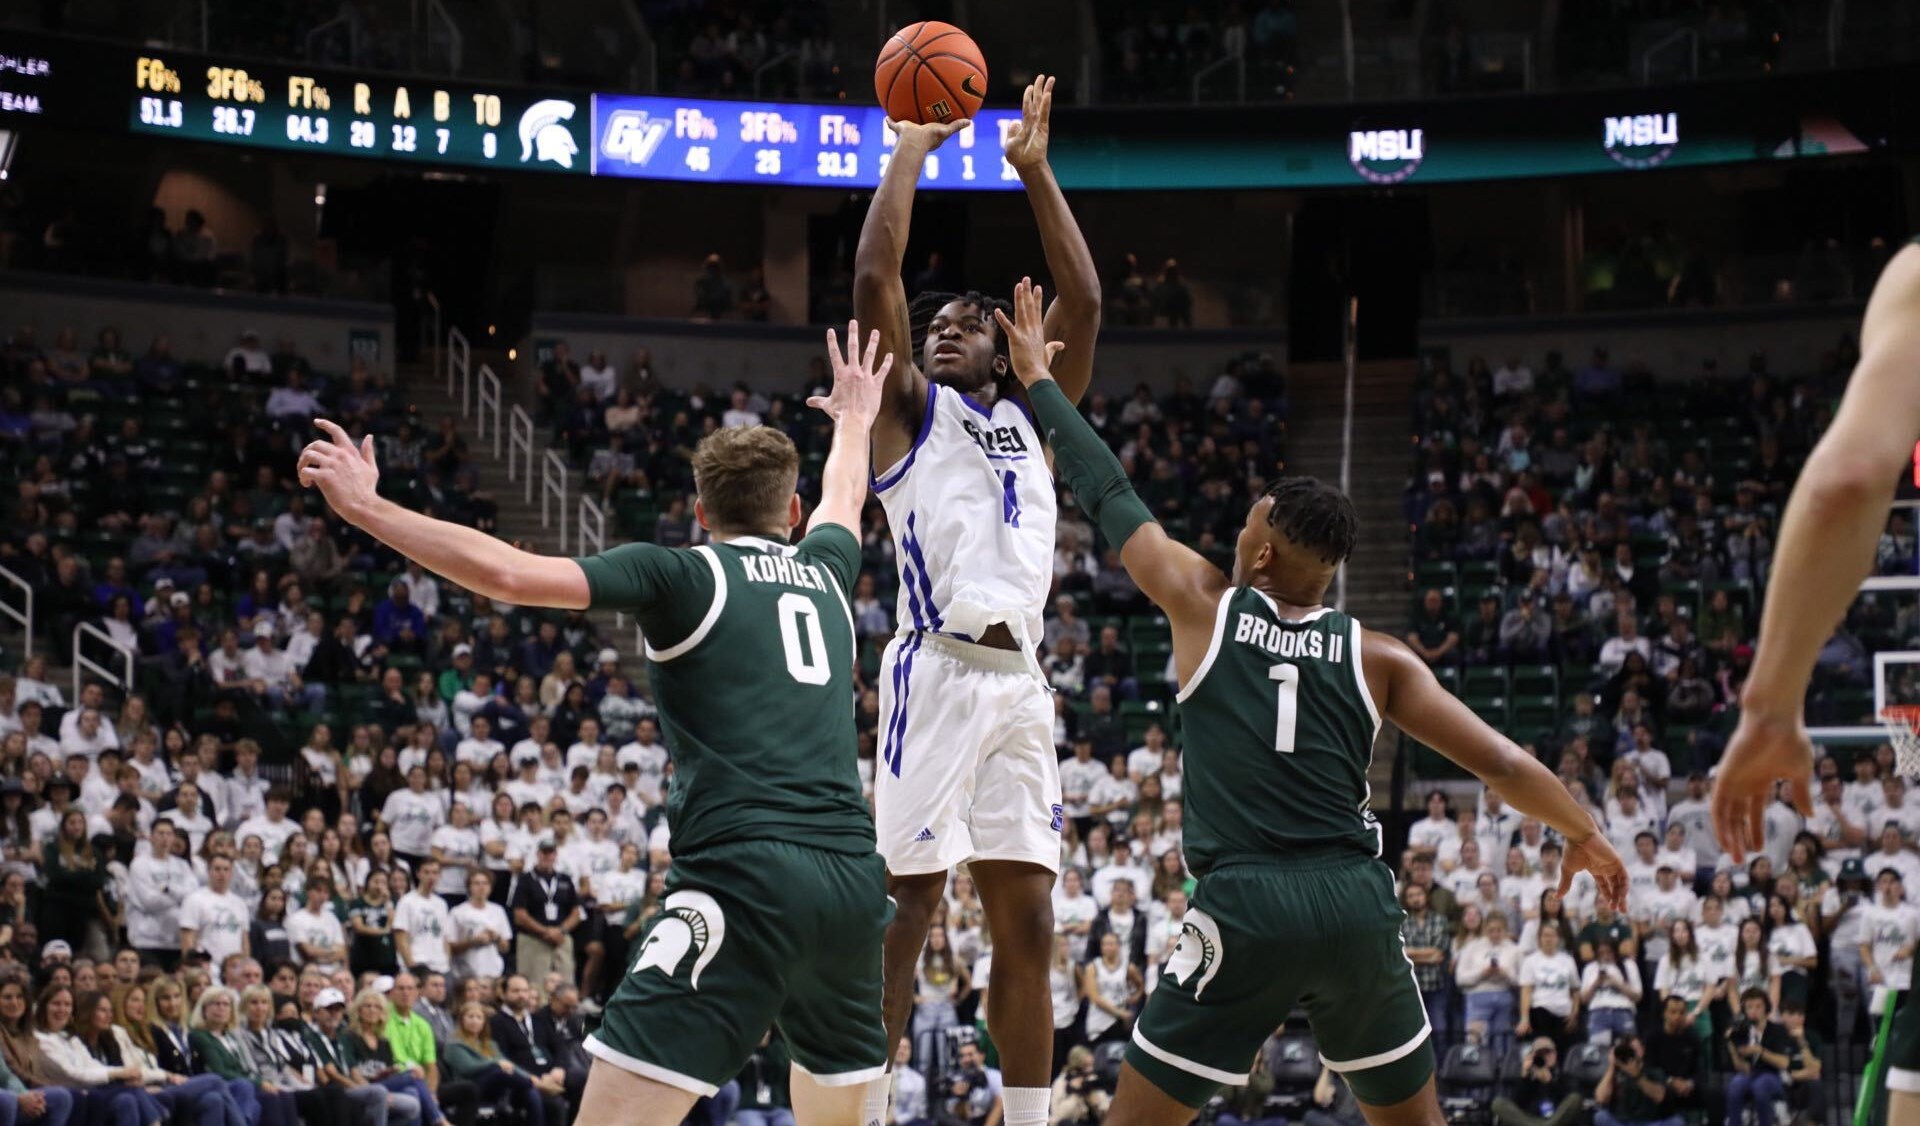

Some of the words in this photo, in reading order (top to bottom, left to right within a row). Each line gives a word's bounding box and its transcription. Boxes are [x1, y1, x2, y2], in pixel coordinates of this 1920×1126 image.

[0, 91, 42, 113] EAM
[137, 57, 181, 93] FG%
[207, 66, 265, 103] 3FG%
[289, 76, 330, 110] FT%
[354, 83, 371, 116] R
[394, 87, 411, 119] A
[473, 93, 500, 127] TO
[392, 124, 416, 152] 12
[436, 128, 449, 154] 7
[675, 108, 718, 140] FG%
[740, 111, 797, 143] 3FG%
[820, 115, 860, 145] FT%
[1604, 113, 1678, 148] MSU
[1350, 129, 1423, 162] MSU
[962, 155, 976, 180] 1
[739, 554, 828, 594] KOHLER
[777, 592, 831, 686] 0
[1234, 612, 1323, 659] BROOKS
[1268, 663, 1299, 754] 1
